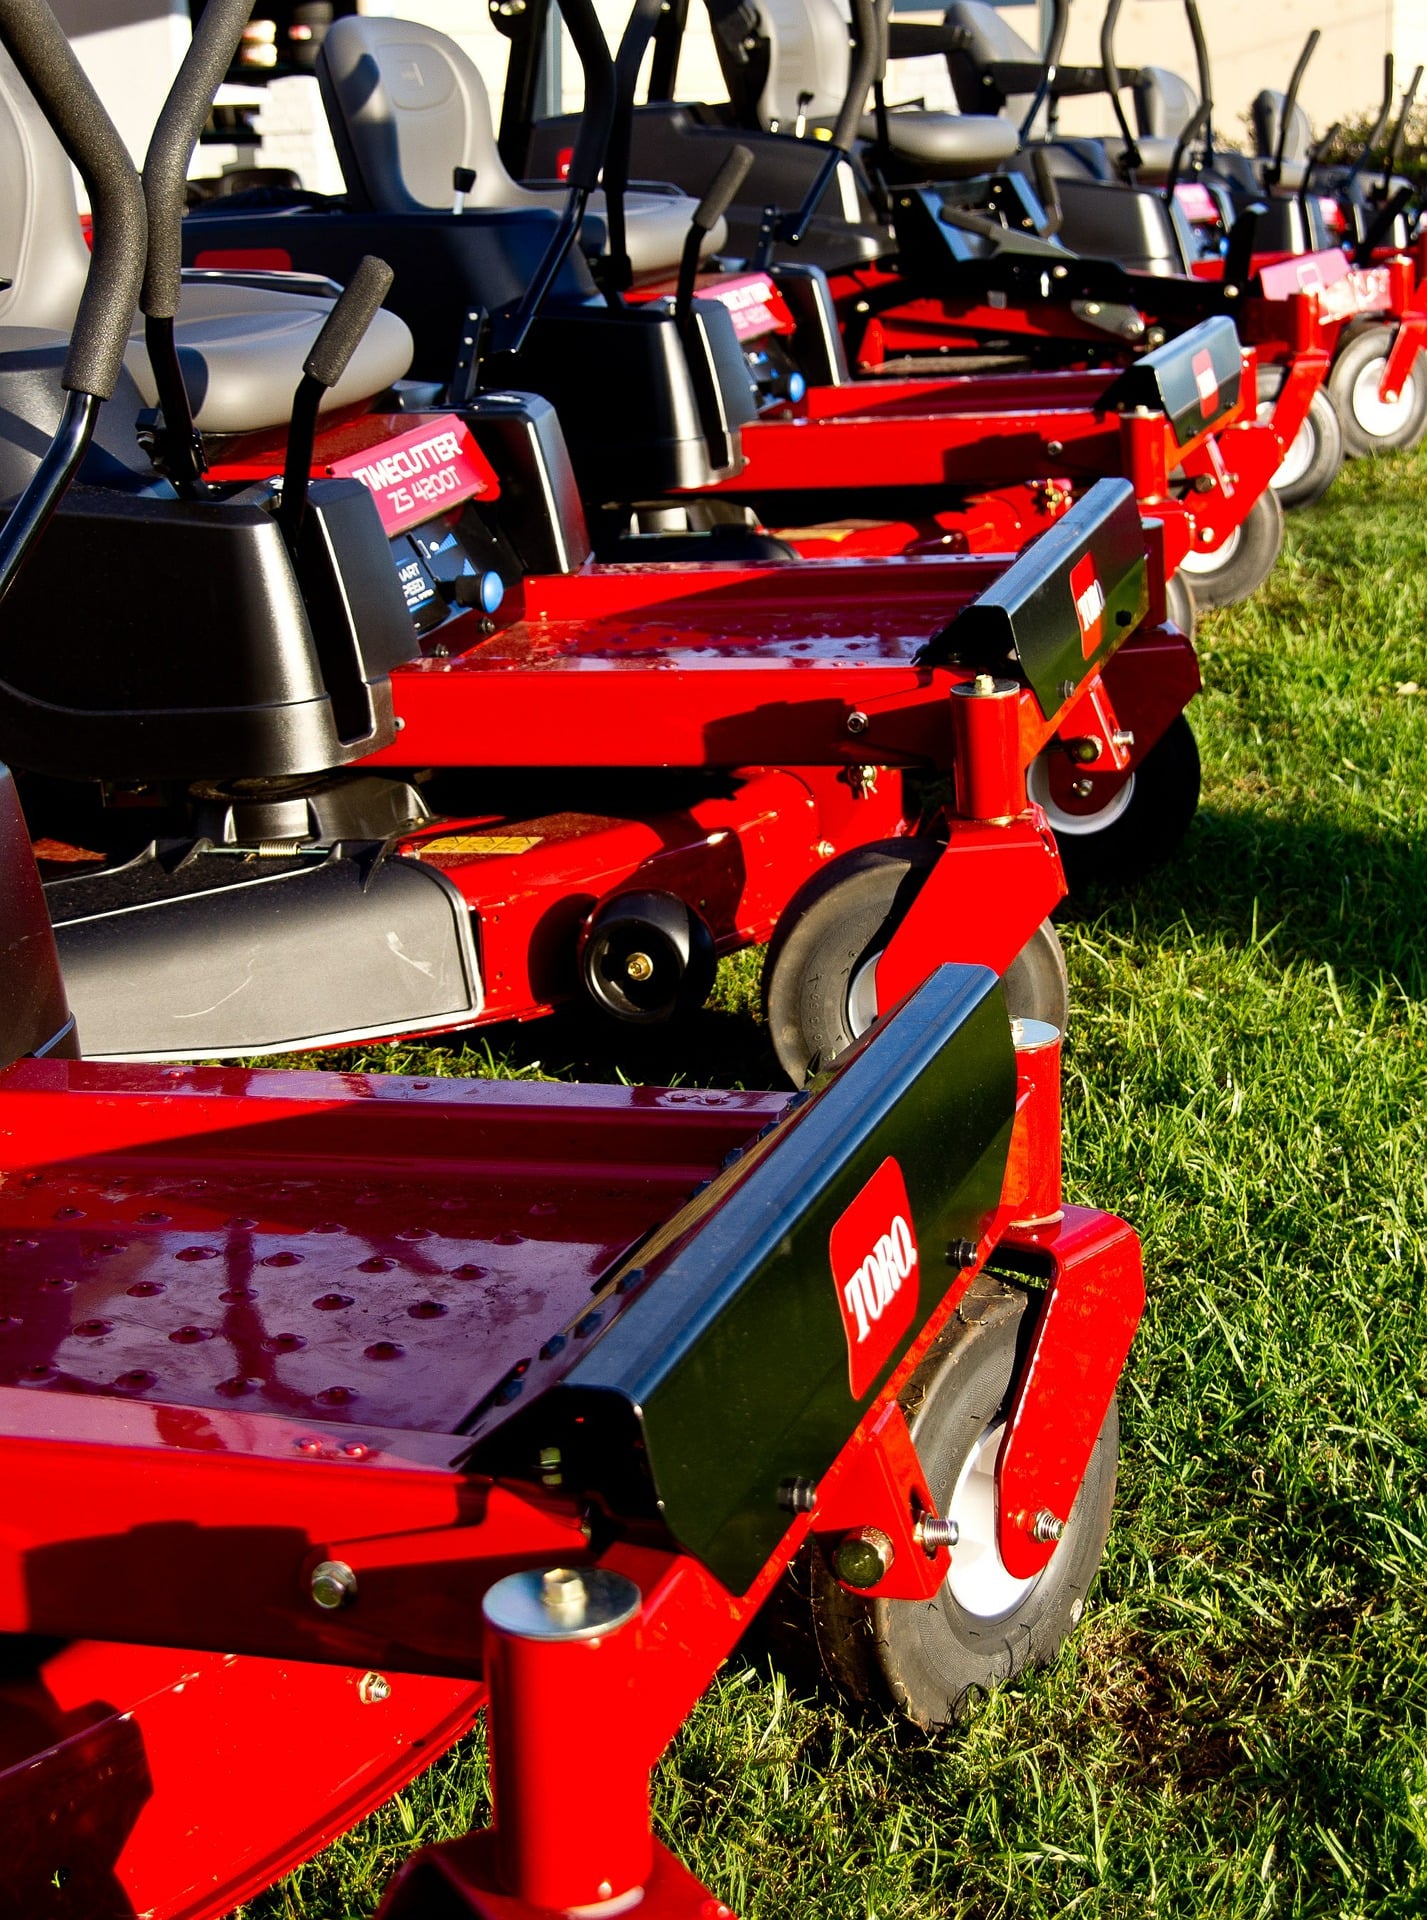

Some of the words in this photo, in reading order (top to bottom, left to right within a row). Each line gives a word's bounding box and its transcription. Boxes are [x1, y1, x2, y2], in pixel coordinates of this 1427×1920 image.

[352, 431, 463, 491] TIMECUTTER
[387, 487, 415, 514] ZS
[413, 465, 462, 501] 4200T
[398, 563, 420, 582] ART
[403, 578, 425, 598] PEED
